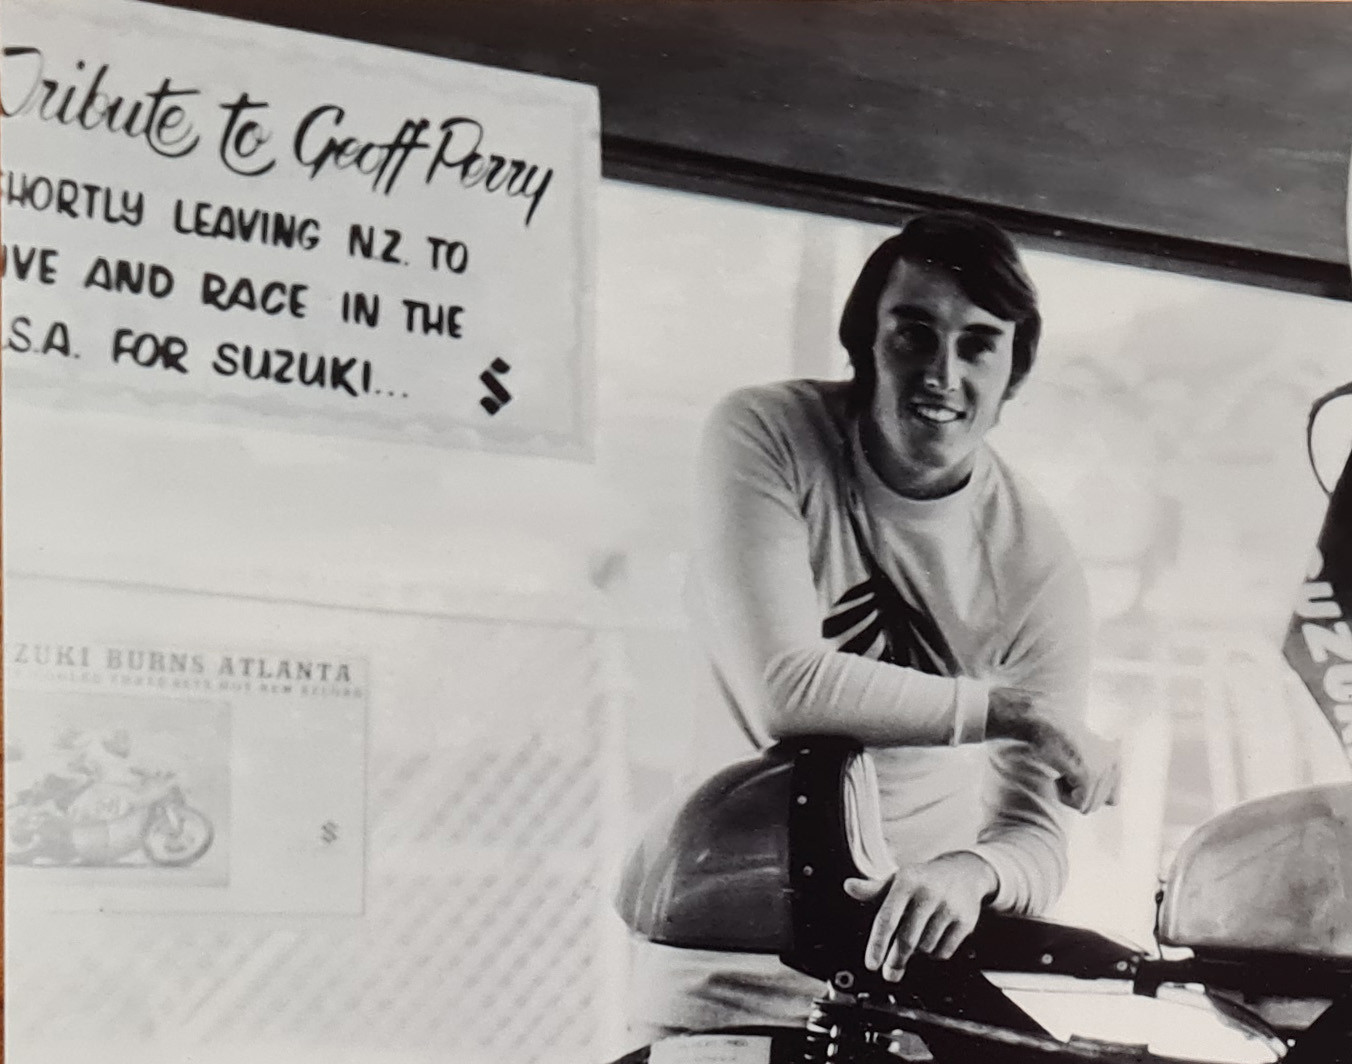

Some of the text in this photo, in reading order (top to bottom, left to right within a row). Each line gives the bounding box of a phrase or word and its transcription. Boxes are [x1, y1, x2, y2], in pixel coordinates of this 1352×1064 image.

[218, 92, 276, 176] to
[294, 104, 430, 195] Geoff
[425, 116, 555, 227] Perry
[1, 172, 145, 226] HORTLY
[173, 200, 320, 249] LEAVING
[427, 236, 469, 273] TO
[84, 257, 174, 298] AND
[202, 272, 308, 318] RACE
[342, 292, 378, 326] IN
[403, 299, 464, 338] THE
[112, 329, 188, 373] FOR
[106, 648, 204, 675] BURNS
[218, 656, 351, 683] ATLANTA
